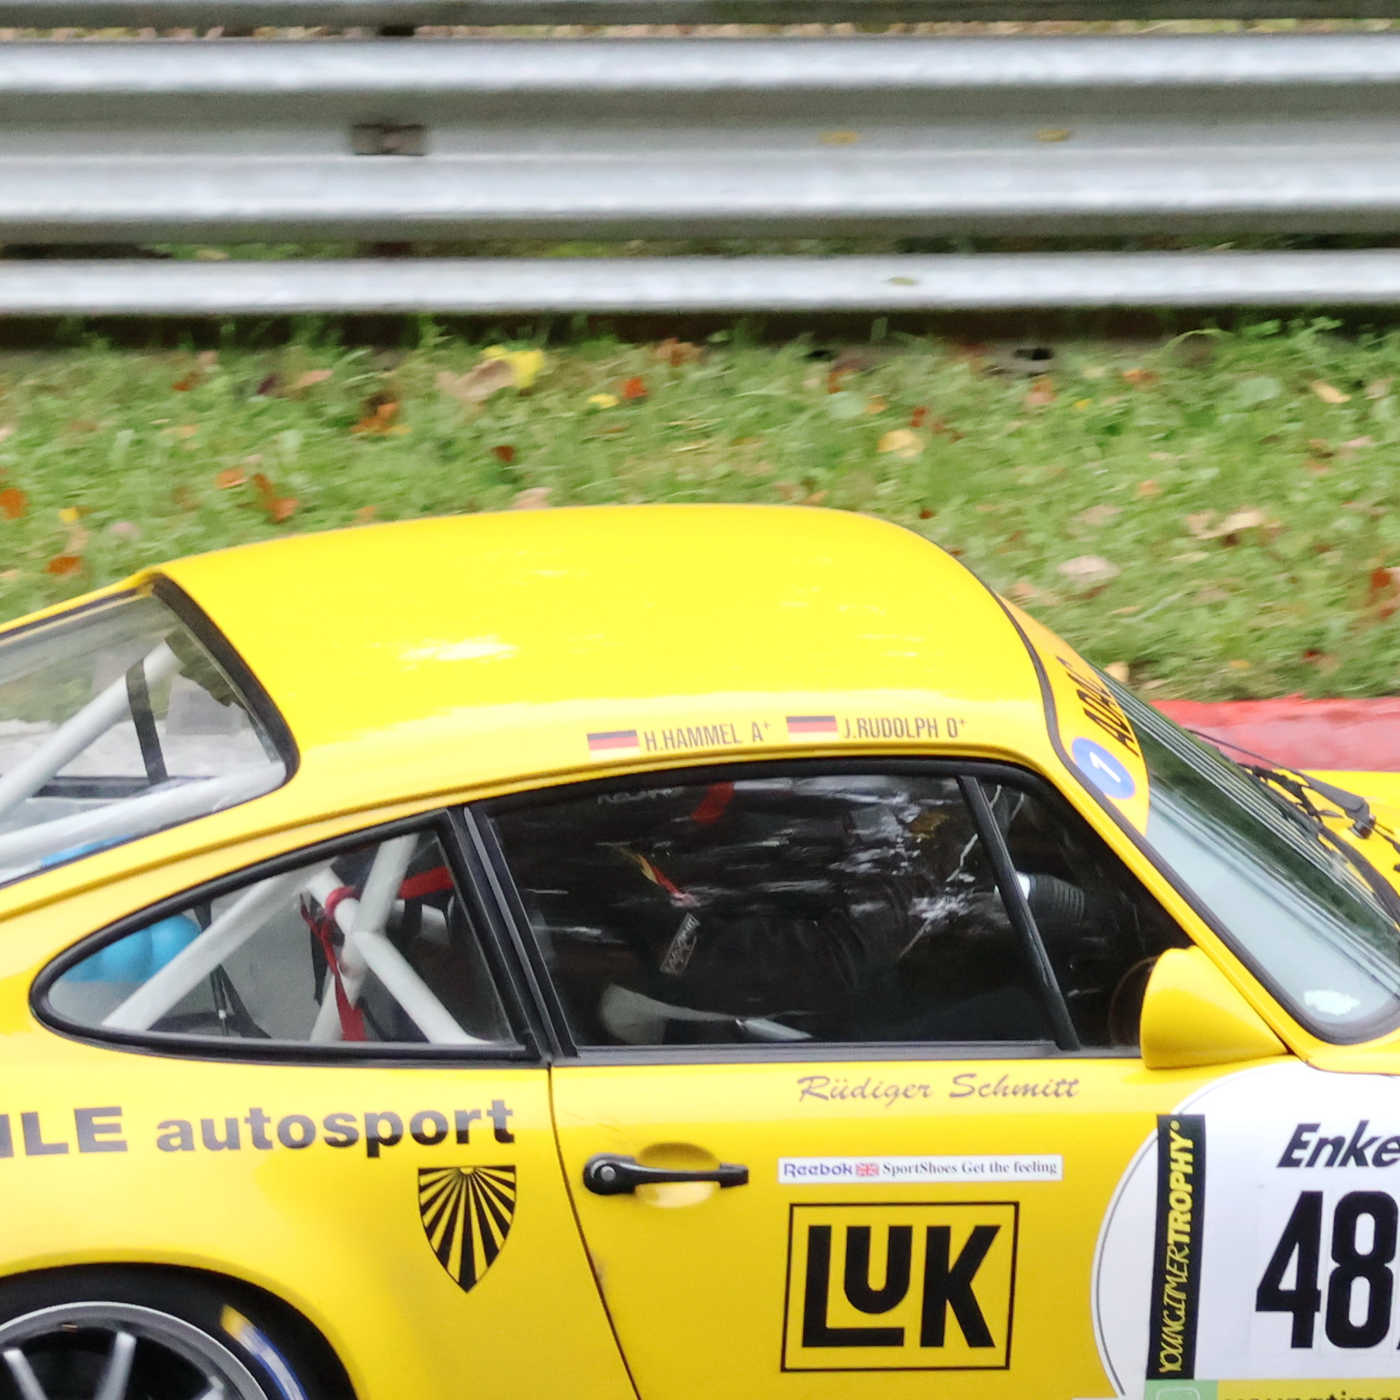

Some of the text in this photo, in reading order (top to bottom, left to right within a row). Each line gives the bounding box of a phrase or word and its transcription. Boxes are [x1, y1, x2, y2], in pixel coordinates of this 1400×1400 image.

[844, 716, 939, 740] J.RUDOLPH
[796, 1072, 1081, 1109] Rüdiger Schmitt
[155, 1098, 515, 1159] autosport
[783, 1162, 853, 1178] Reebok
[961, 1160, 986, 1175] Get
[988, 1159, 1012, 1174] the
[1013, 1158, 1058, 1176] feeling
